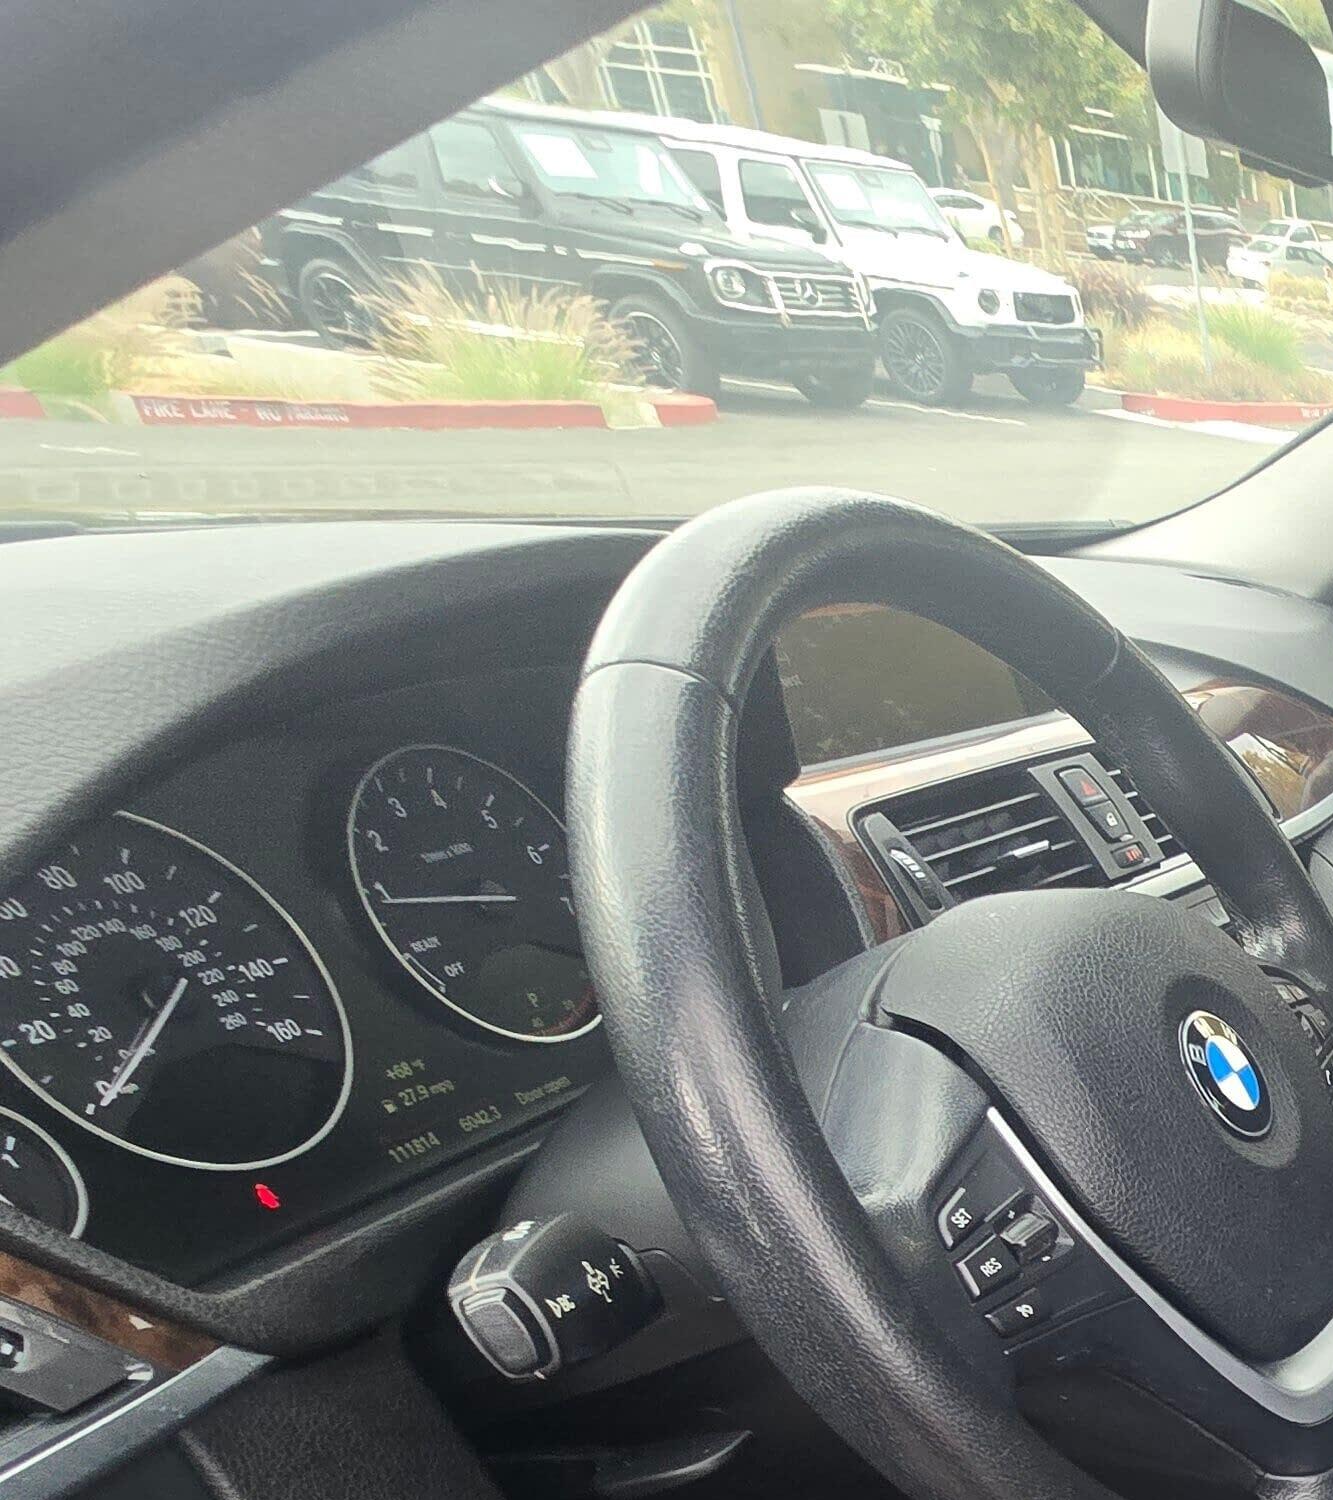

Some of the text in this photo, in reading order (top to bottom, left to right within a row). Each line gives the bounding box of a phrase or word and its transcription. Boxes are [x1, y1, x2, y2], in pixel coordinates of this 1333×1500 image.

[143, 399, 184, 418] FIRE
[190, 400, 236, 420] LANE
[388, 798, 407, 818] 3
[430, 788, 447, 809] 4
[480, 809, 498, 829] 5
[367, 831, 389, 851] 2
[526, 846, 543, 865] 6
[37, 865, 78, 890] 80
[104, 867, 145, 894] 100
[179, 904, 217, 928] 120
[71, 924, 101, 941] 120
[98, 918, 127, 936] 140
[129, 923, 157, 940] 160
[56, 940, 87, 957] 100
[155, 935, 183, 952] 180
[409, 936, 442, 954] READY
[51, 959, 78, 976] 80
[177, 950, 207, 967] 200
[197, 968, 225, 985] 220
[239, 958, 274, 982] 140
[444, 962, 465, 978] OFF
[54, 978, 79, 995] 60
[211, 990, 240, 1007] 240
[67, 1003, 91, 1018] 40
[220, 1012, 247, 1030] 260
[267, 1018, 302, 1042] 160
[18, 1020, 57, 1045] 20
[88, 1026, 112, 1043] 20
[398, 1085, 429, 1107] 27.9
[458, 1105, 502, 1132] 6042.3
[951, 1207, 973, 1229] SET
[980, 1257, 1003, 1278] RES
